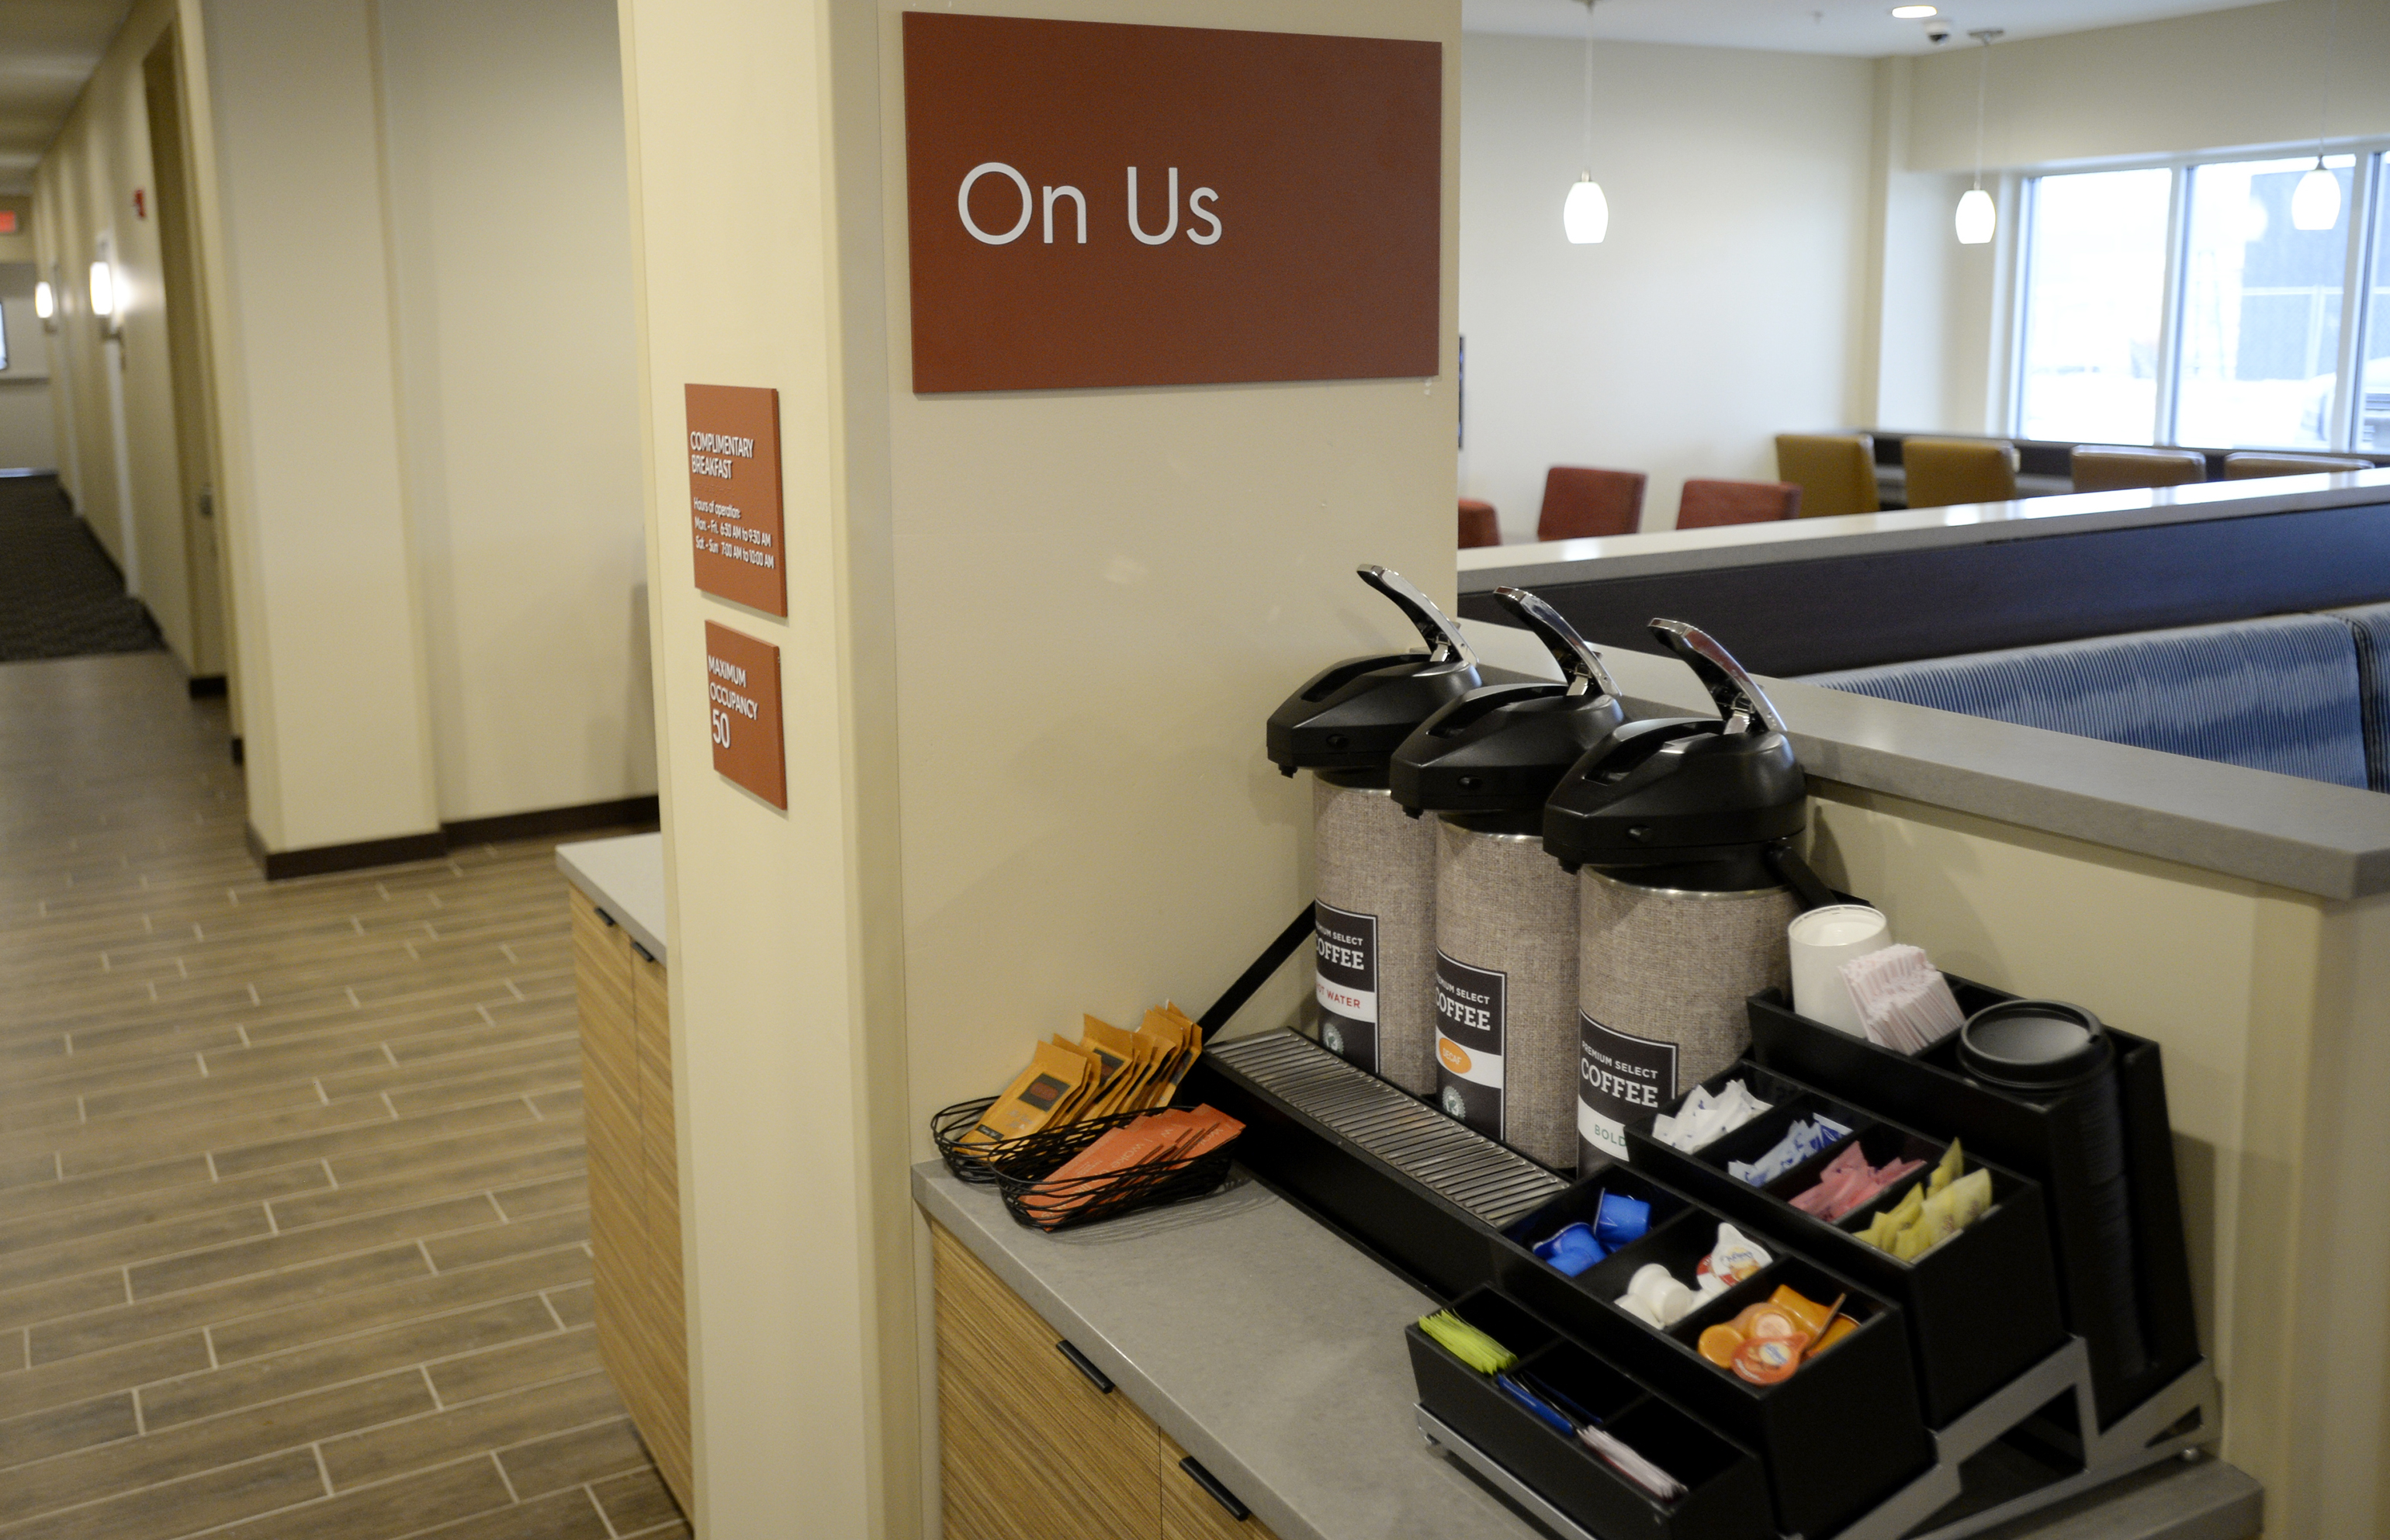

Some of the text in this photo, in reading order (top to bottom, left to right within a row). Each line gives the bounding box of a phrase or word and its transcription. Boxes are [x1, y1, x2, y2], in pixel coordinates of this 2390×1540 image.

[958, 161, 1223, 246] On Us
[690, 431, 754, 459] COMPLIMENTARY
[691, 454, 733, 479] BREAKFAST
[694, 497, 708, 512] Hours
[708, 500, 715, 514] of
[720, 522, 732, 538] 6:30
[733, 525, 742, 540] AM
[742, 528, 748, 542] to
[749, 528, 760, 545] 9:30
[761, 532, 772, 548] AM
[721, 542, 733, 558] 7:00
[733, 545, 743, 560] AM
[743, 548, 749, 562] to
[749, 549, 764, 566] 10:00
[764, 553, 774, 569] AM
[708, 655, 747, 688] MAXIMUM
[709, 682, 759, 721] OCCUPANCY
[712, 708, 731, 749] 50
[1332, 932, 1363, 946] SELECT
[1317, 934, 1365, 971] OFFEE
[1327, 989, 1360, 1009] WATER
[1456, 988, 1490, 1005] SELECT
[1443, 1047, 1462, 1064] DECAF
[1581, 1040, 1658, 1080] PREMIUM SELECT
[1581, 1057, 1658, 1108] COFFEE
[1595, 1124, 1626, 1147] BOLD
[1111, 1142, 1145, 1168] wake
